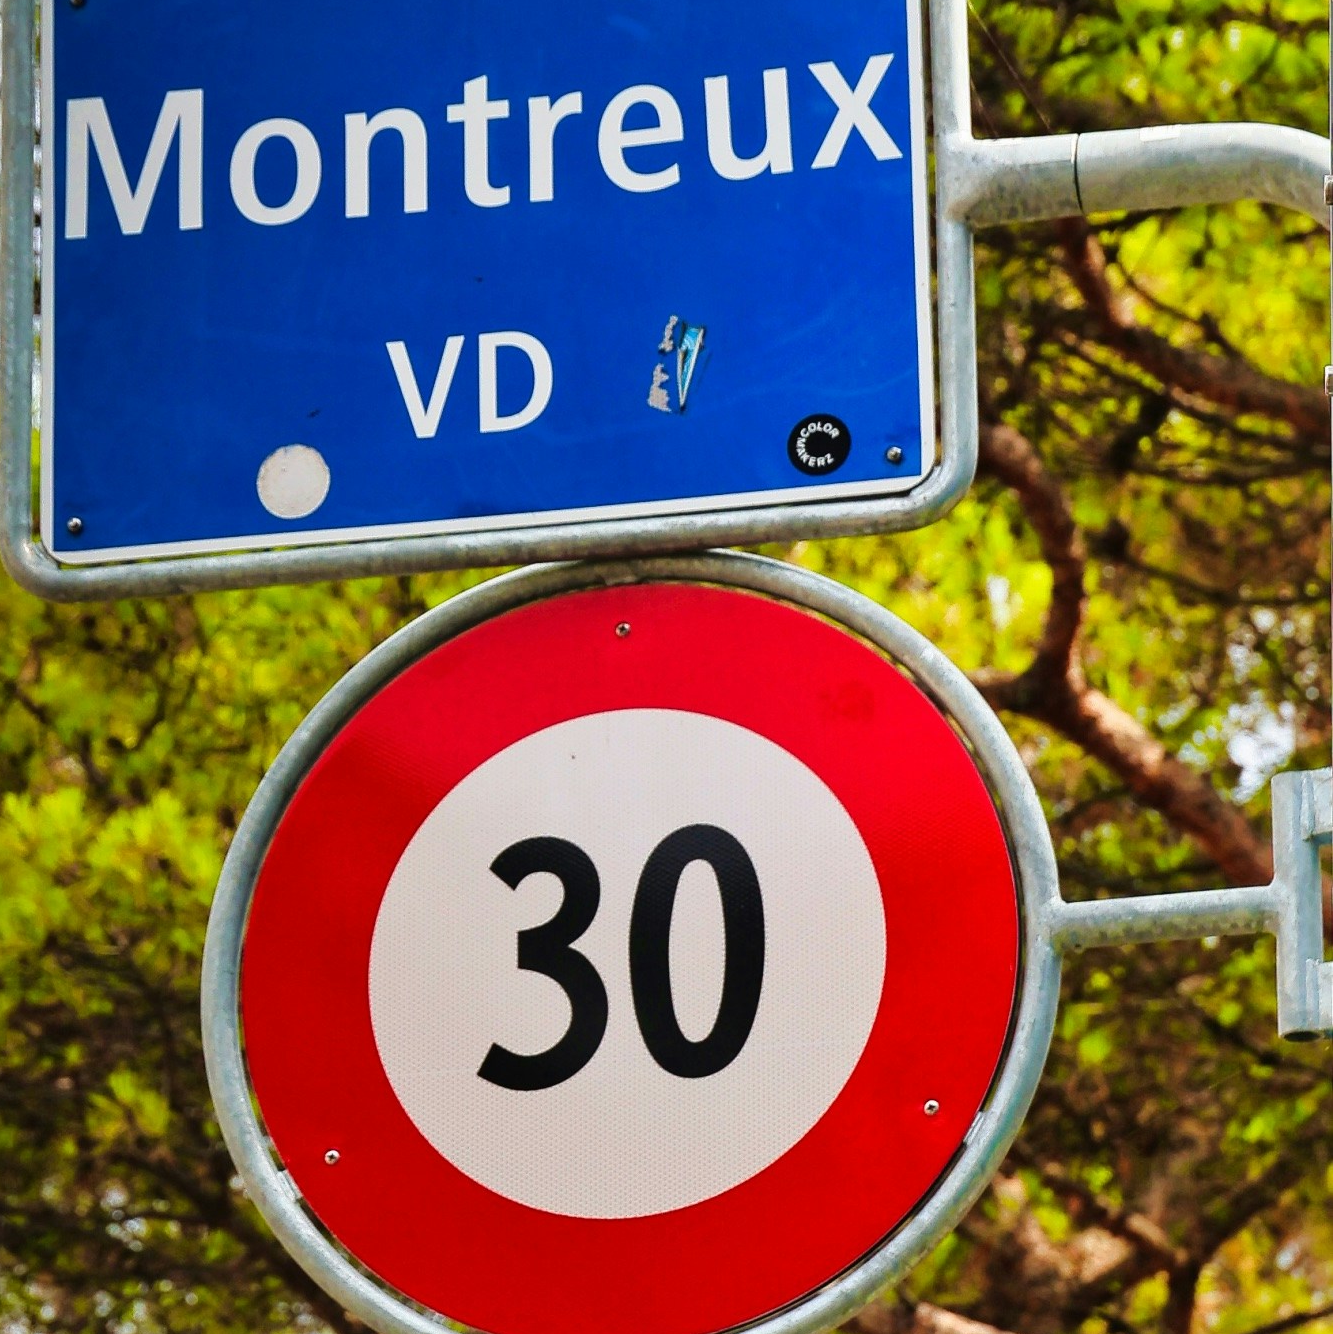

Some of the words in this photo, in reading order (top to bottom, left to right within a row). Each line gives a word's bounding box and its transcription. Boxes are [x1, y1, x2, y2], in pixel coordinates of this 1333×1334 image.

[64, 53, 903, 240] Montreux
[386, 330, 553, 439] VD
[800, 421, 840, 439] COLOR
[796, 437, 834, 467] MAKERZ
[477, 823, 766, 1091] 30
